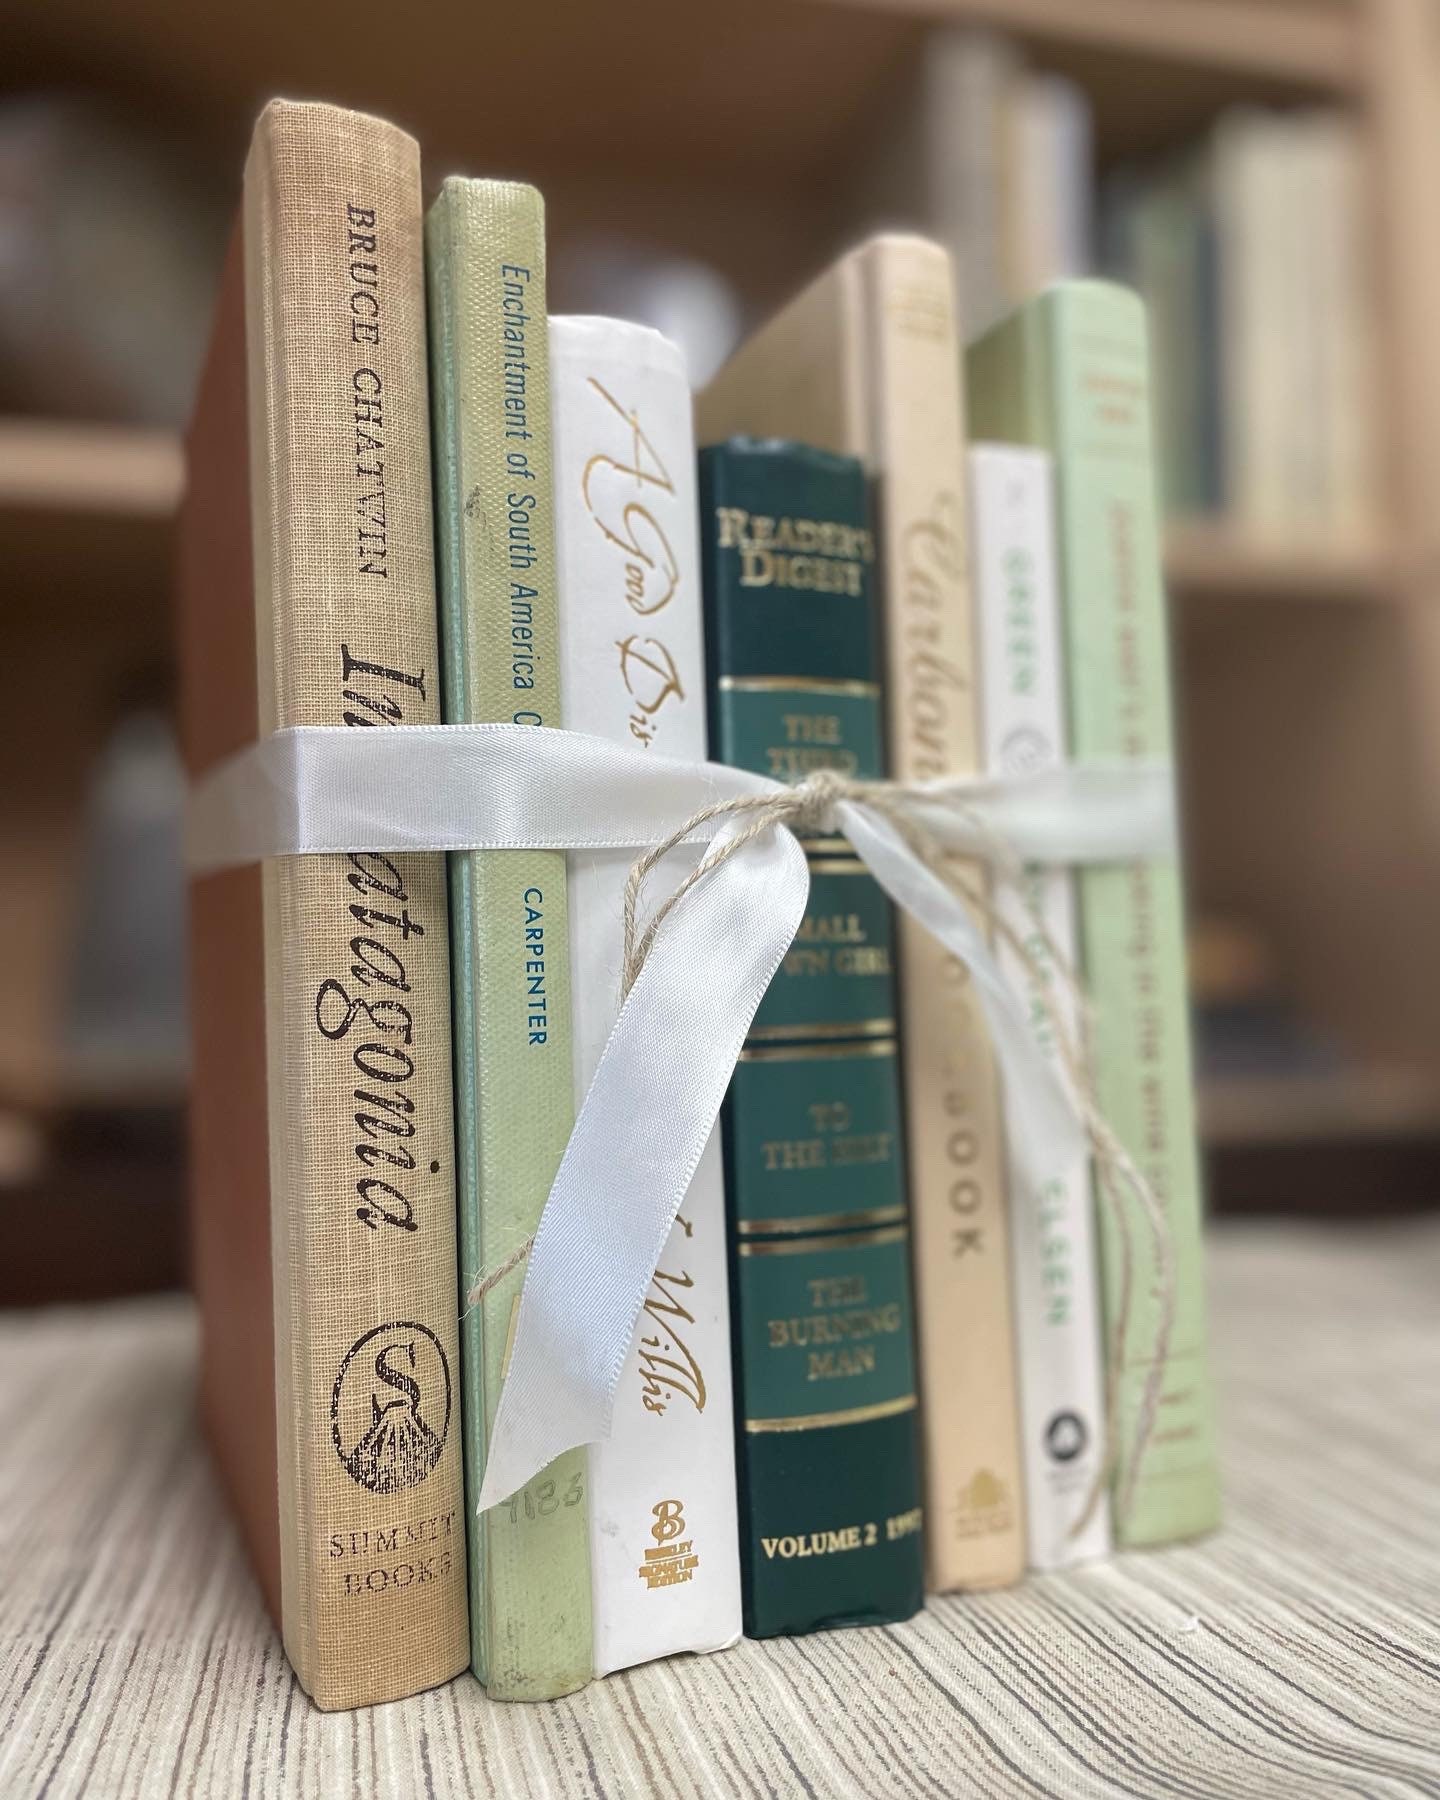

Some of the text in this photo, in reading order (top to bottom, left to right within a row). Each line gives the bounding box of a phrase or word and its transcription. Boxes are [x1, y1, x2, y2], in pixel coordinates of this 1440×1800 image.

[500, 264, 530, 440] Enchantment
[347, 203, 387, 579] BRUCE CHATWIN
[506, 452, 534, 481] of
[506, 491, 537, 570] South
[583, 376, 685, 749] A Good Dis
[739, 541, 863, 597] DIGEST
[509, 582, 542, 690] America
[905, 492, 968, 787] Carbon
[783, 714, 842, 745] THE
[797, 912, 867, 943] MALL
[523, 887, 549, 1047] CARPENTER
[316, 852, 440, 1232] atagonia
[810, 1104, 851, 1132] TO
[761, 1138, 826, 1171] THE
[638, 1269, 707, 1417] Willis
[767, 1303, 901, 1348] BURNING
[806, 1345, 876, 1381] MAN
[761, 1525, 861, 1559] VOLUME
[863, 1521, 878, 1547] 2
[344, 1551, 453, 1597] BOOKS
